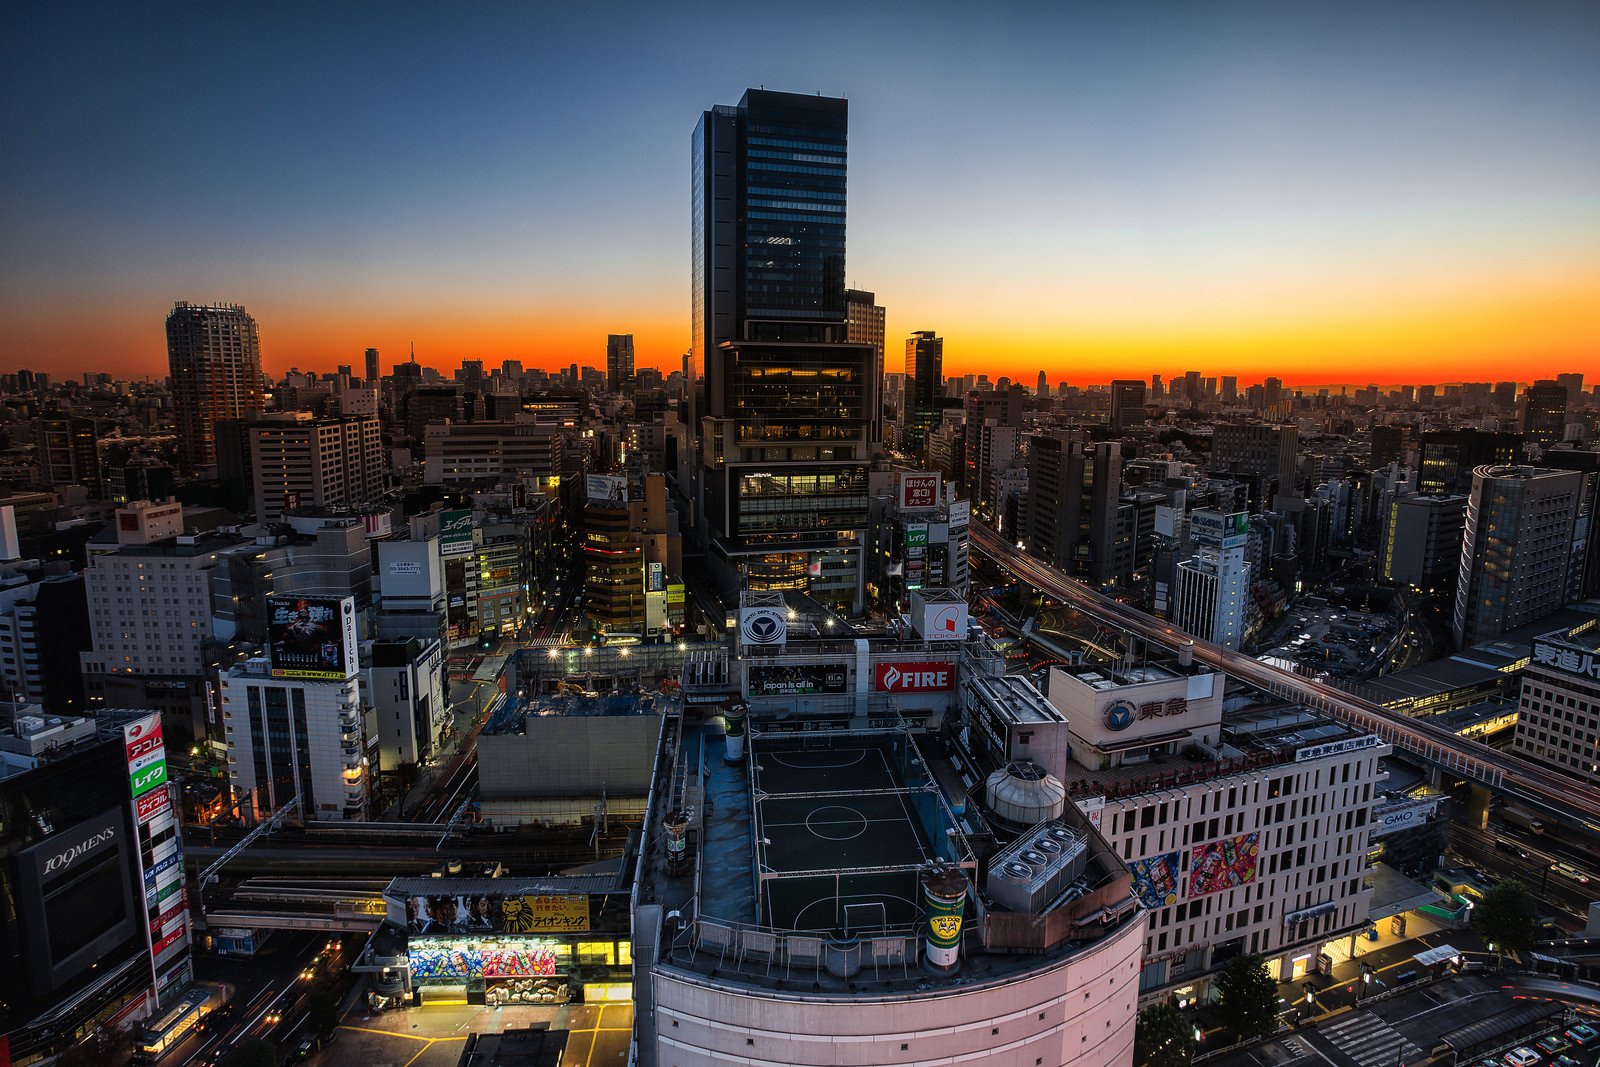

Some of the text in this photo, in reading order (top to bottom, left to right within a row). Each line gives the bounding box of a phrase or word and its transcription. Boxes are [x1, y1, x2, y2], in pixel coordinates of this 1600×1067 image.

[906, 479, 936, 488] ほけんの
[441, 515, 472, 531] エイブル
[909, 534, 926, 542] レイク
[345, 616, 355, 673] Daiichi
[763, 680, 787, 691] japan
[788, 680, 795, 689] is
[796, 680, 806, 688] all
[806, 679, 814, 688] in
[902, 671, 948, 688] FIRE
[1138, 698, 1188, 721] 東急
[131, 737, 164, 757] アコム
[1299, 736, 1377, 760] 東急東横店南館
[134, 766, 164, 789] レイク
[139, 795, 168, 814] アイフル
[1384, 811, 1413, 825] GMO
[533, 915, 587, 928] ライオンキング
